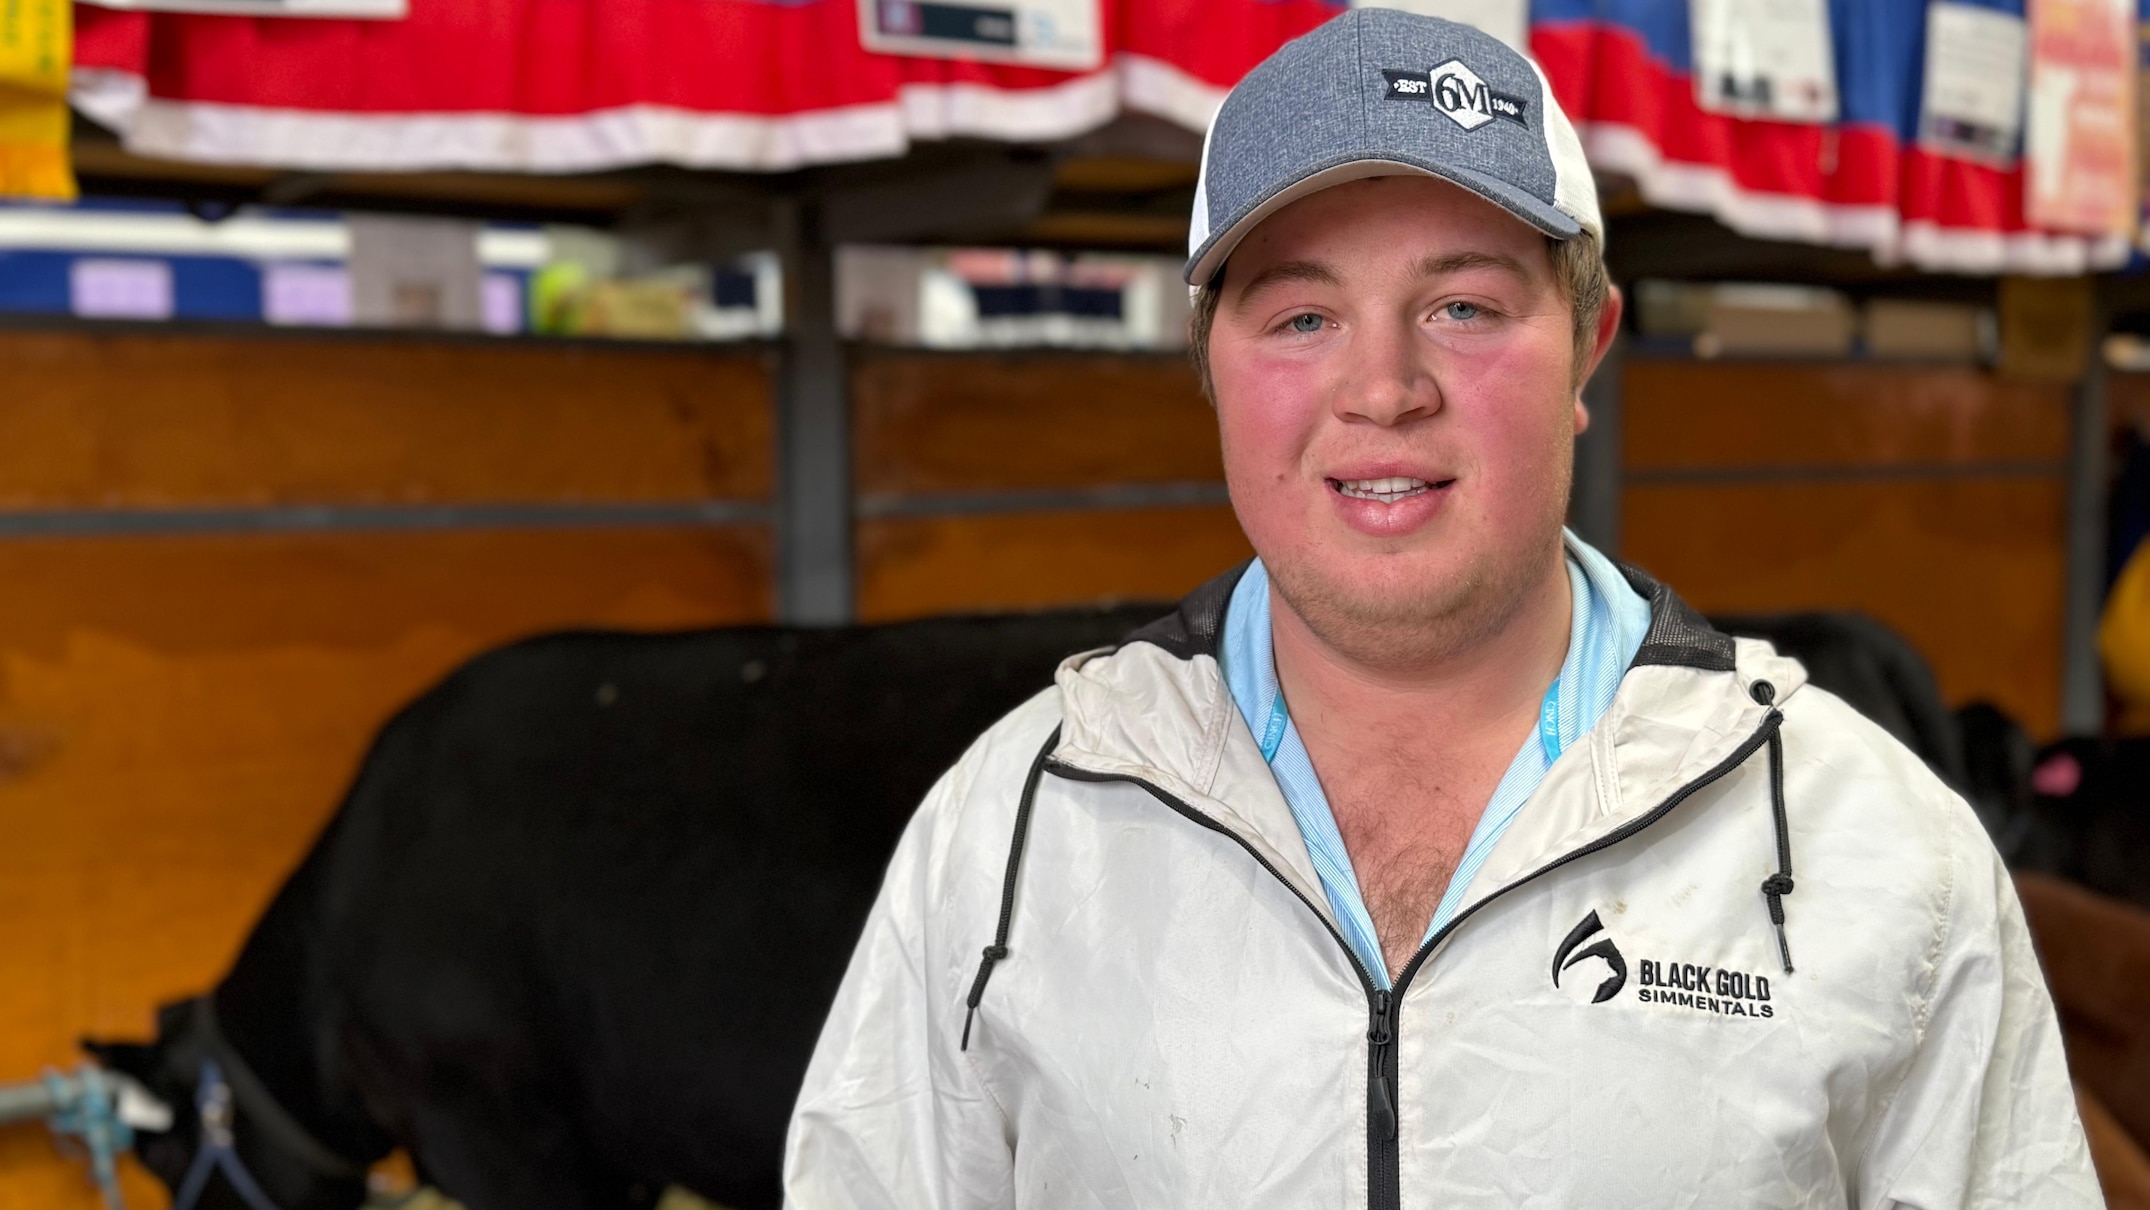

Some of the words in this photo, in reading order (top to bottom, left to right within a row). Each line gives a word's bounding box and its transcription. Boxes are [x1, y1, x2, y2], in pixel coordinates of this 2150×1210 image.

[1397, 79, 1428, 94] EST
[1435, 73, 1492, 116] 6M
[1640, 959, 1712, 994] BLACK
[1716, 968, 1771, 1001] GOLD
[1638, 988, 1775, 1019] SIMMENTALS
